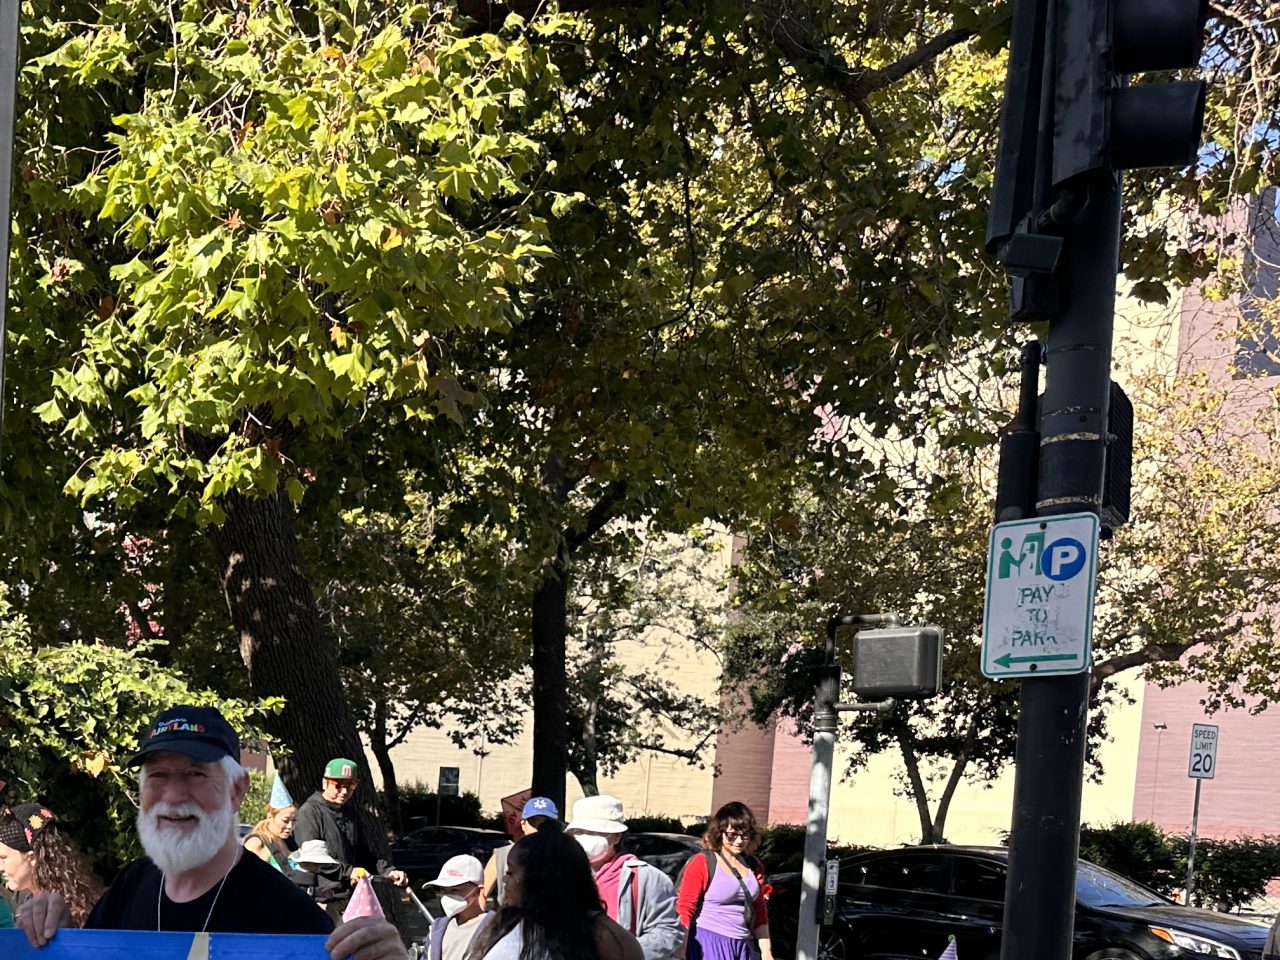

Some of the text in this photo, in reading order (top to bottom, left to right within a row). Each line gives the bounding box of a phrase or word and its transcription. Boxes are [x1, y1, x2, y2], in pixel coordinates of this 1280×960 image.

[1051, 545, 1079, 576] P
[1021, 585, 1054, 604] PAY
[1026, 608, 1047, 622] TO
[1194, 730, 1216, 739] SPEED
[1195, 742, 1213, 750] LIMIT
[1192, 753, 1213, 773] 20
